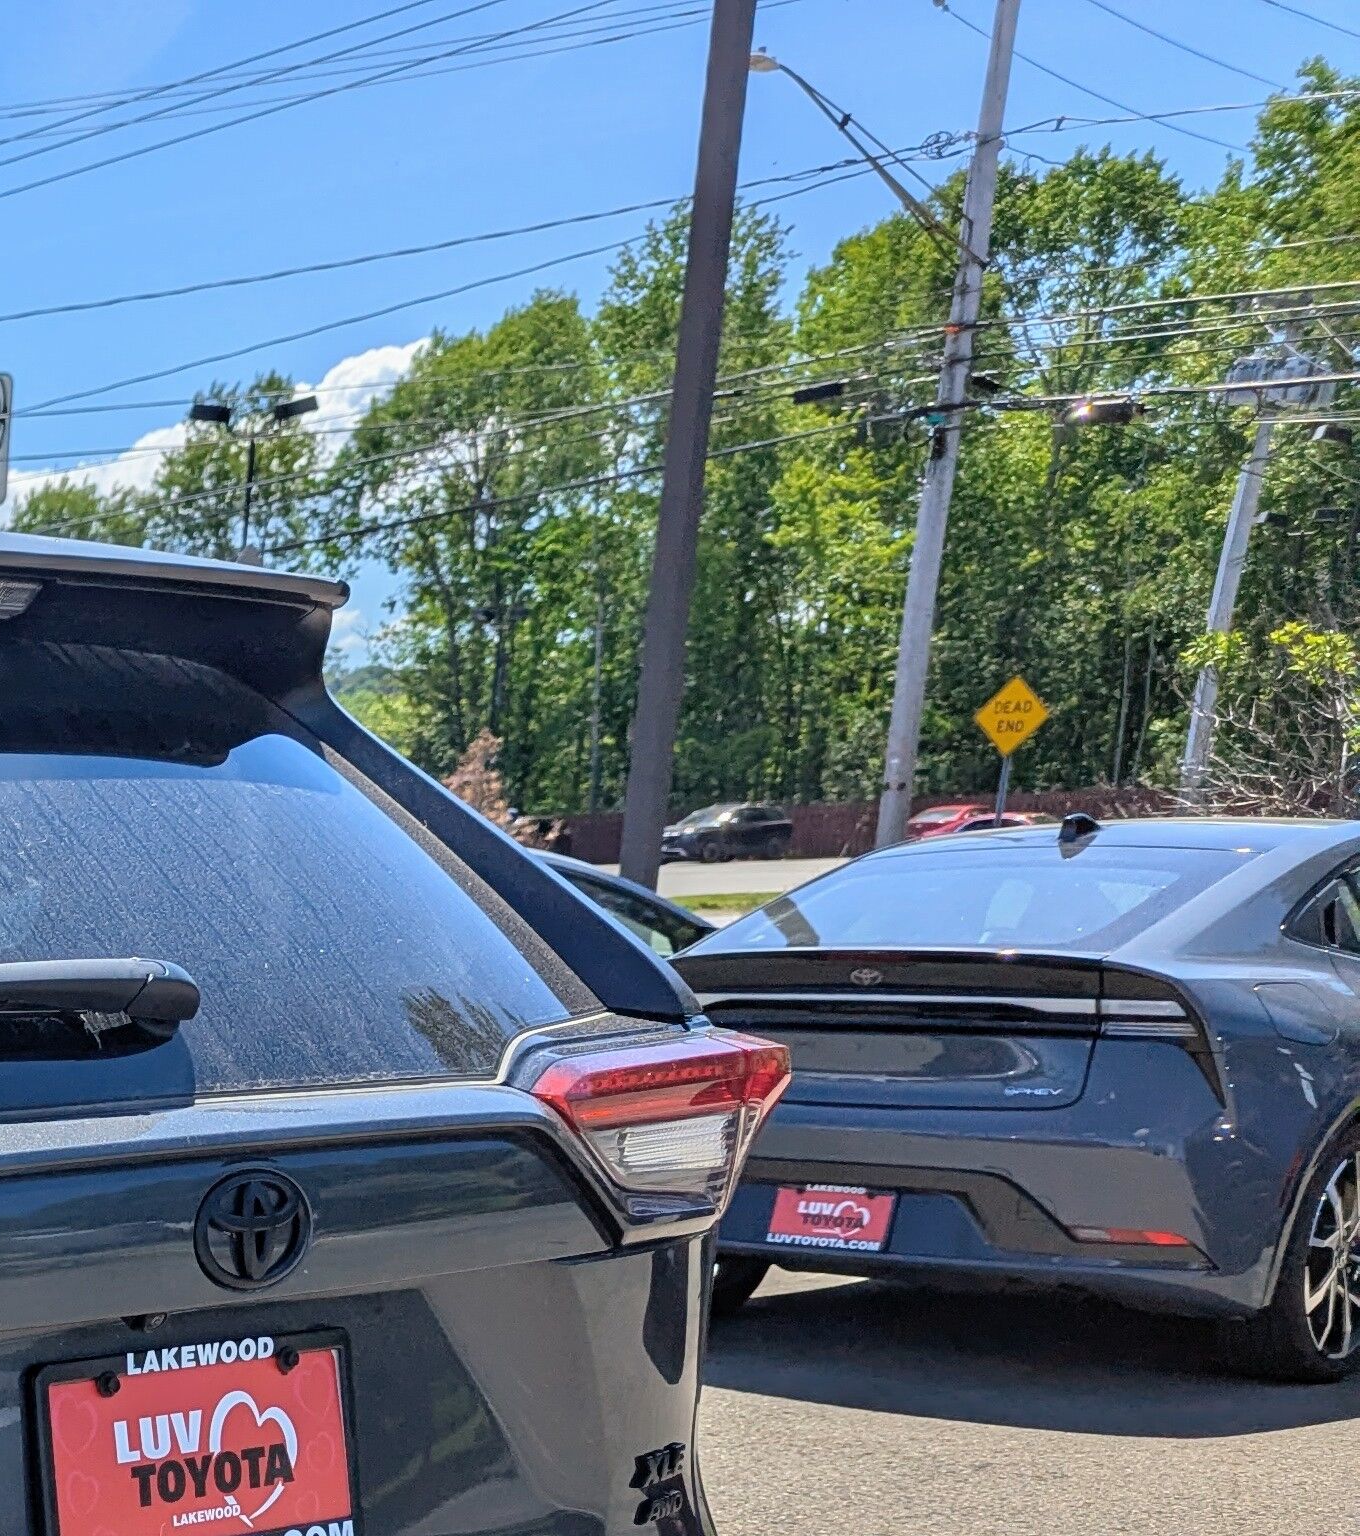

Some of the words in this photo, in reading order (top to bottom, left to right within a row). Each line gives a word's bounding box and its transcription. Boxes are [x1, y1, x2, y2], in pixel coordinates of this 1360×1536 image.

[994, 700, 1032, 714] DEAD
[997, 720, 1024, 733] END
[805, 1184, 867, 1195] LAKEWOOD
[797, 1200, 835, 1216] LUV
[801, 1214, 865, 1229] TOYOTA
[765, 1232, 881, 1251] LUVTOYOTA.COM
[126, 1336, 274, 1375] LAKEWOOD
[113, 1409, 202, 1464] LUV
[131, 1443, 295, 1507] TOYOTA
[172, 1504, 241, 1527] LAKEWOOD
